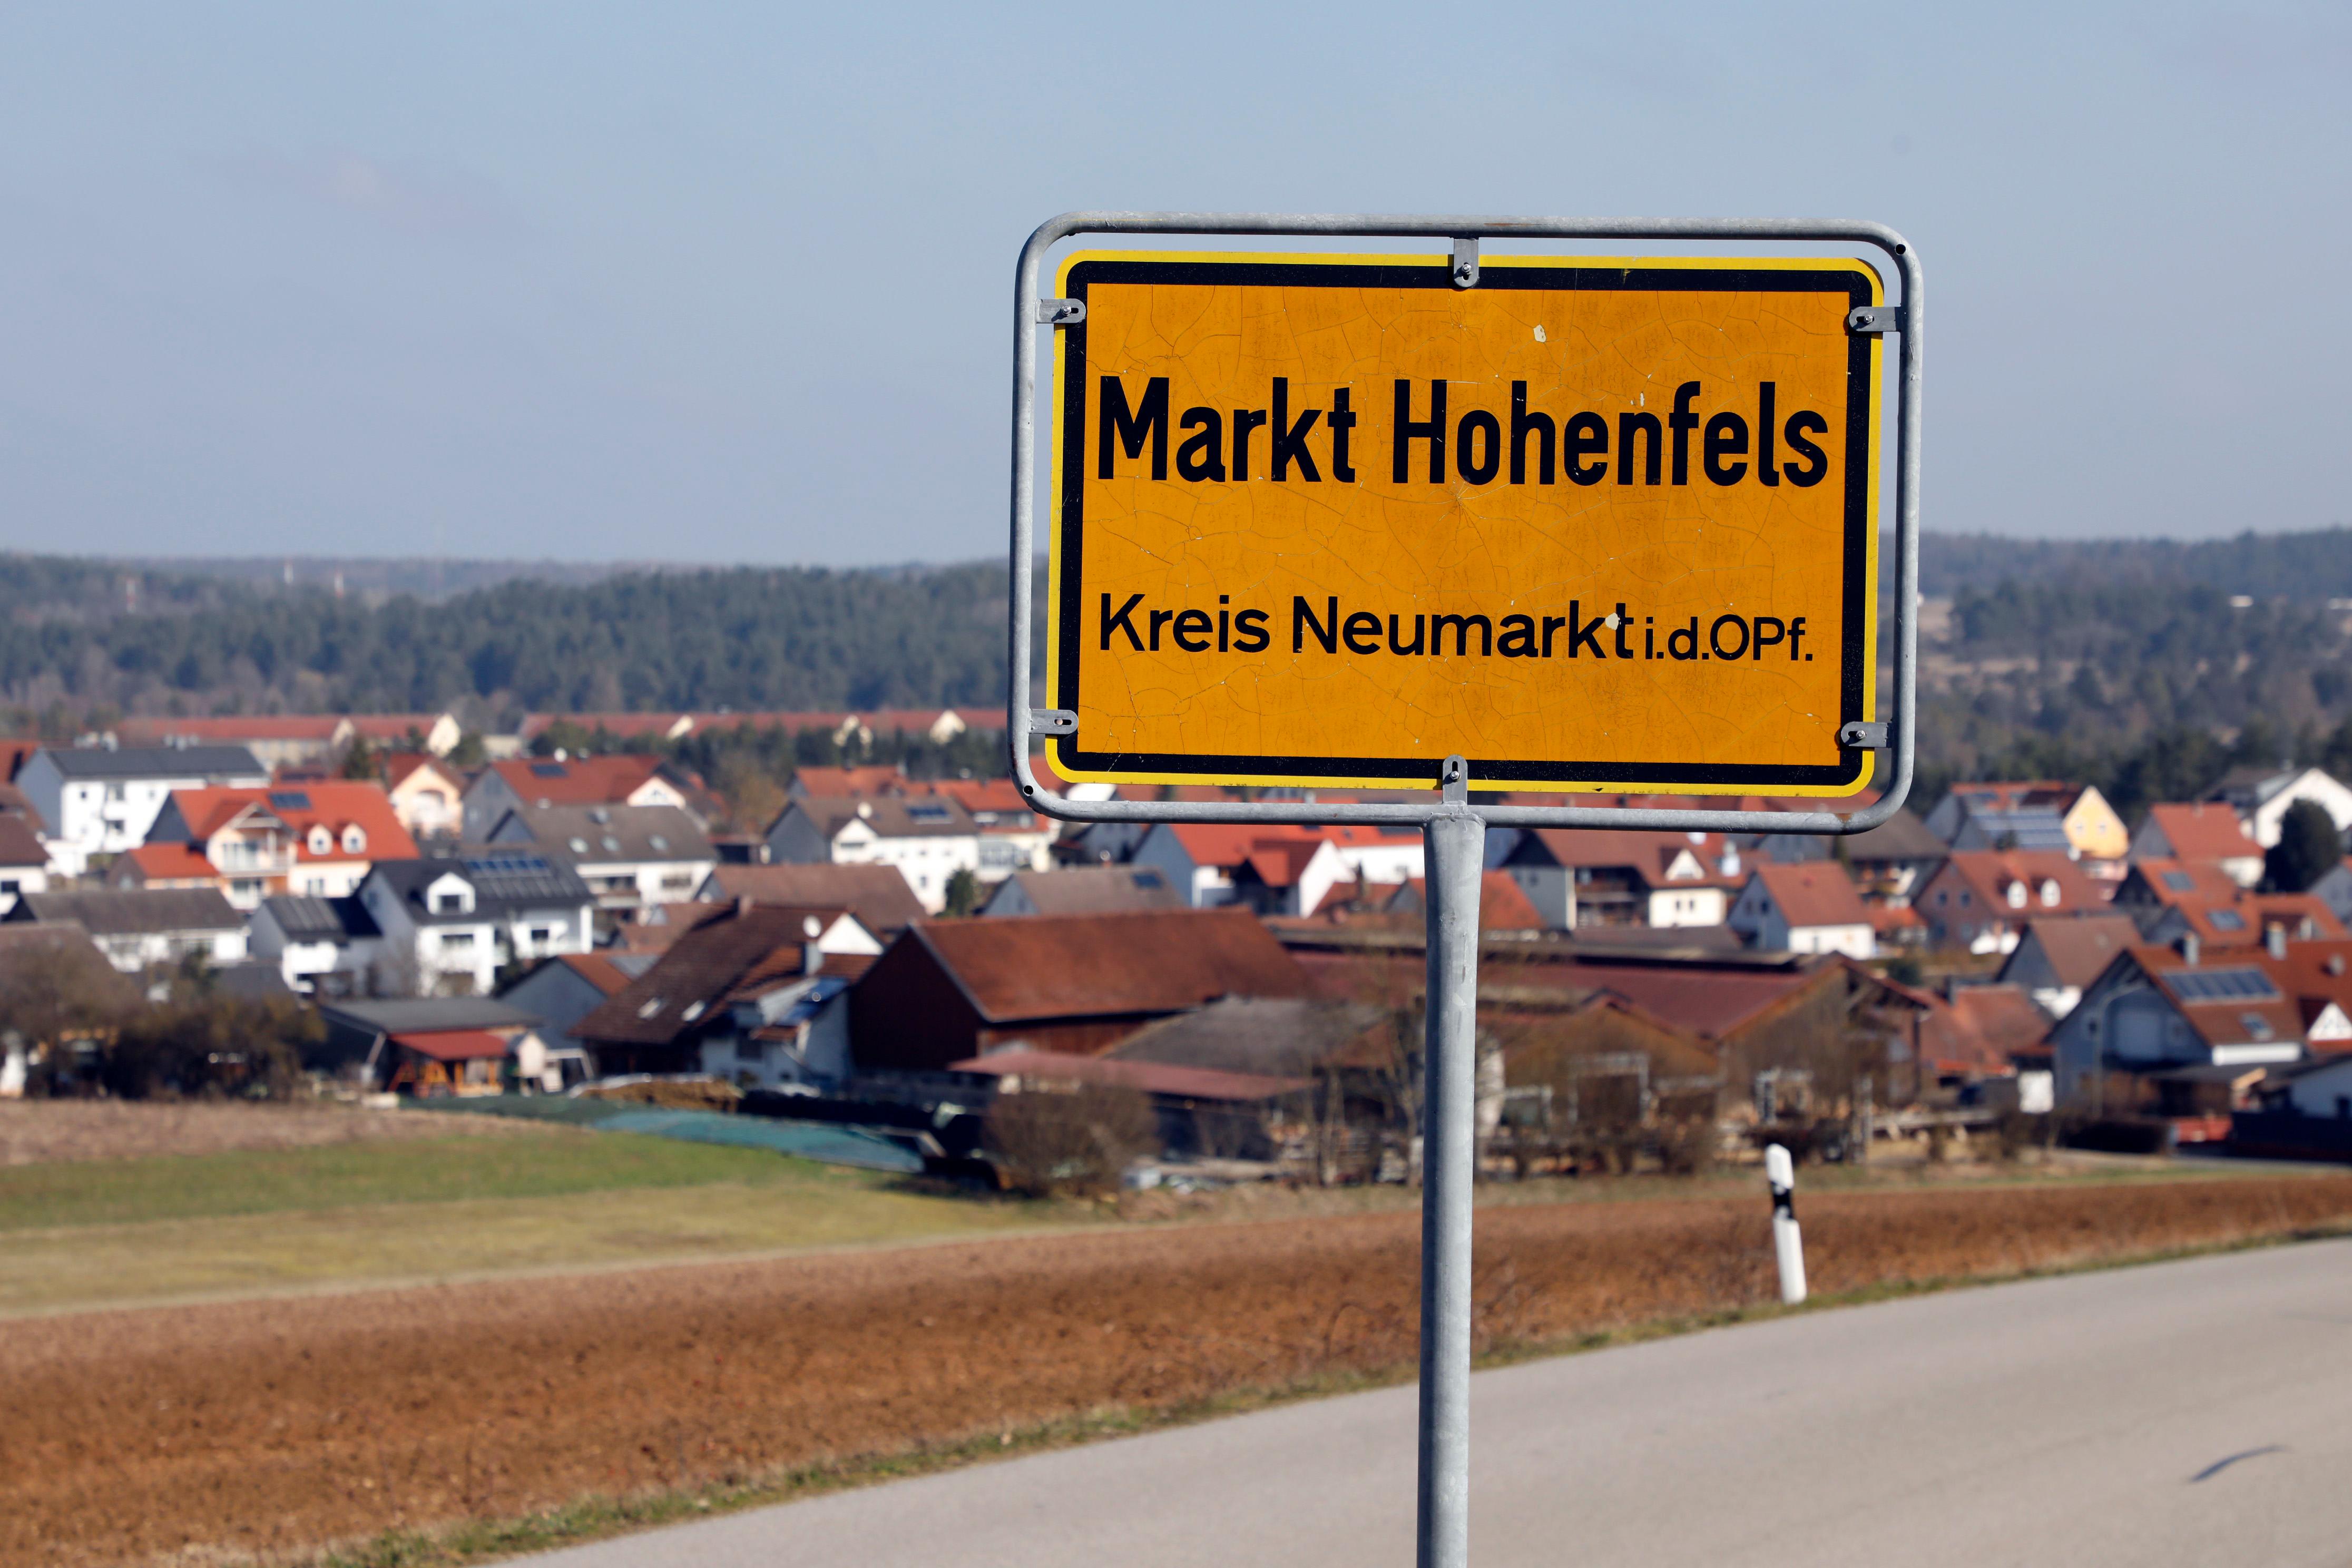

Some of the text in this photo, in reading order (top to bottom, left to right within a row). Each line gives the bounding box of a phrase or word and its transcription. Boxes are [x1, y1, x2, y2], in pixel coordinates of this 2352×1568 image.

[1098, 376, 1829, 488] Markt Hohenfels
[1100, 592, 1271, 653] Kreis
[1292, 595, 1635, 660] Neumarkt
